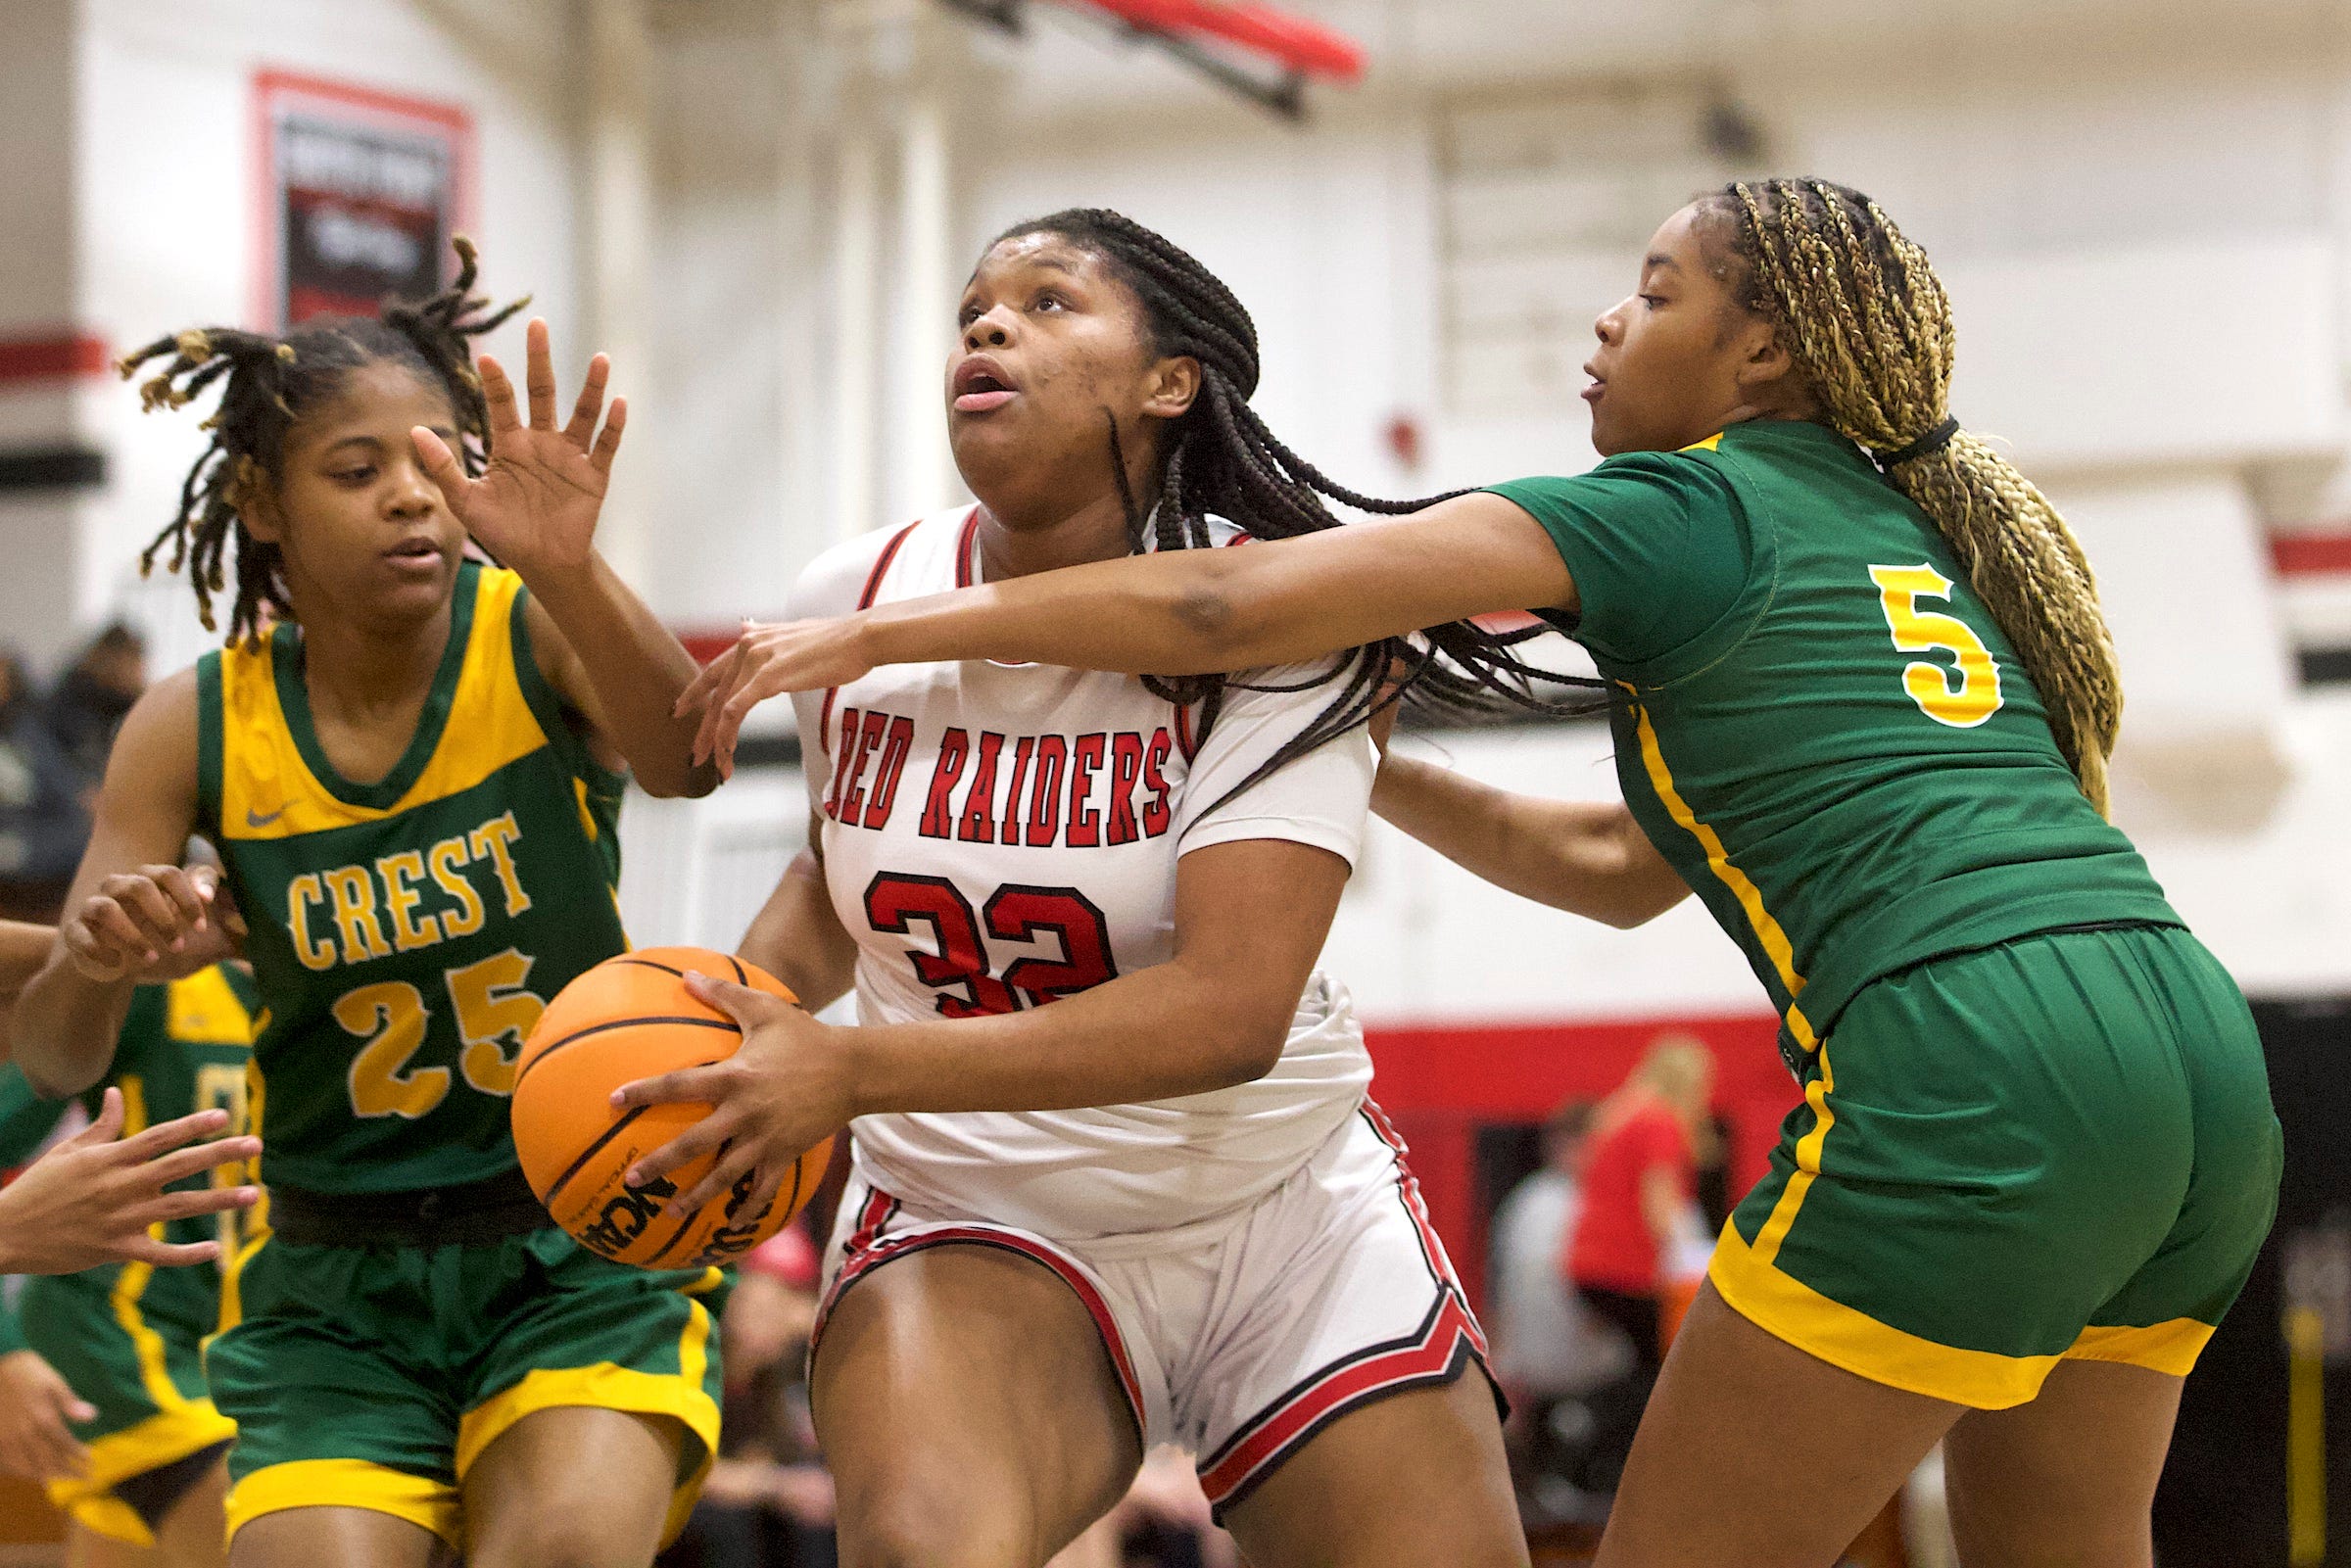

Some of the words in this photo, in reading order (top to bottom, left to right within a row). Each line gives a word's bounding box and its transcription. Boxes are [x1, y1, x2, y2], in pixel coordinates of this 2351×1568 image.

[1867, 562, 2005, 728] 5
[825, 707, 915, 831] RED
[919, 727, 1172, 847] RAIDERS
[288, 809, 532, 971] CREST
[863, 870, 1119, 1019] 32
[332, 947, 547, 1119] 25
